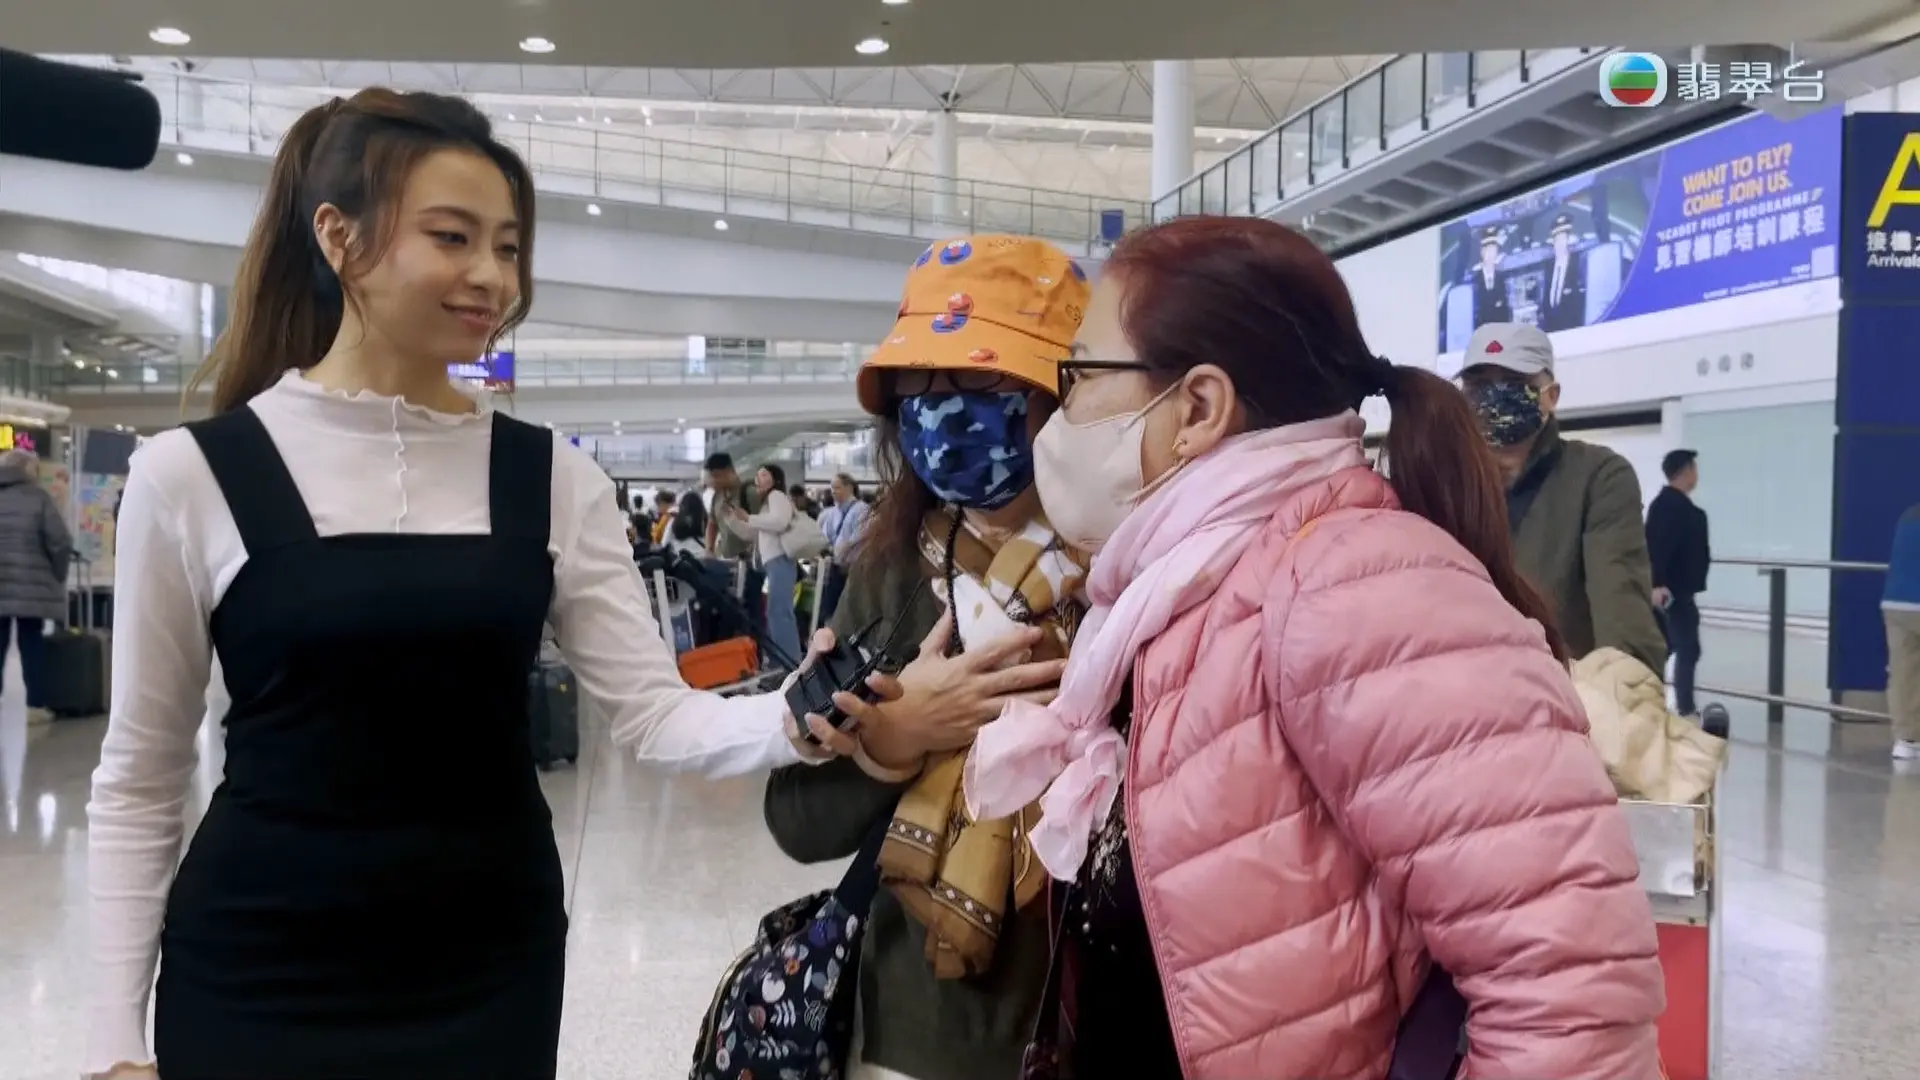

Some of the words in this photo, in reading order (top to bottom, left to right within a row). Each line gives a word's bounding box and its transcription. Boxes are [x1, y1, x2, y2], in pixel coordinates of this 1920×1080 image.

[1683, 163, 1728, 193] WANT
[1731, 156, 1753, 180] TO
[1757, 142, 1792, 172] FLY?
[1666, 221, 1698, 241] CADET
[1701, 212, 1731, 230] PILOT
[1735, 191, 1809, 221] PROGRAMME
[1683, 188, 1724, 217] COME
[1728, 177, 1763, 204] JOIN
[1767, 171, 1793, 193] US.
